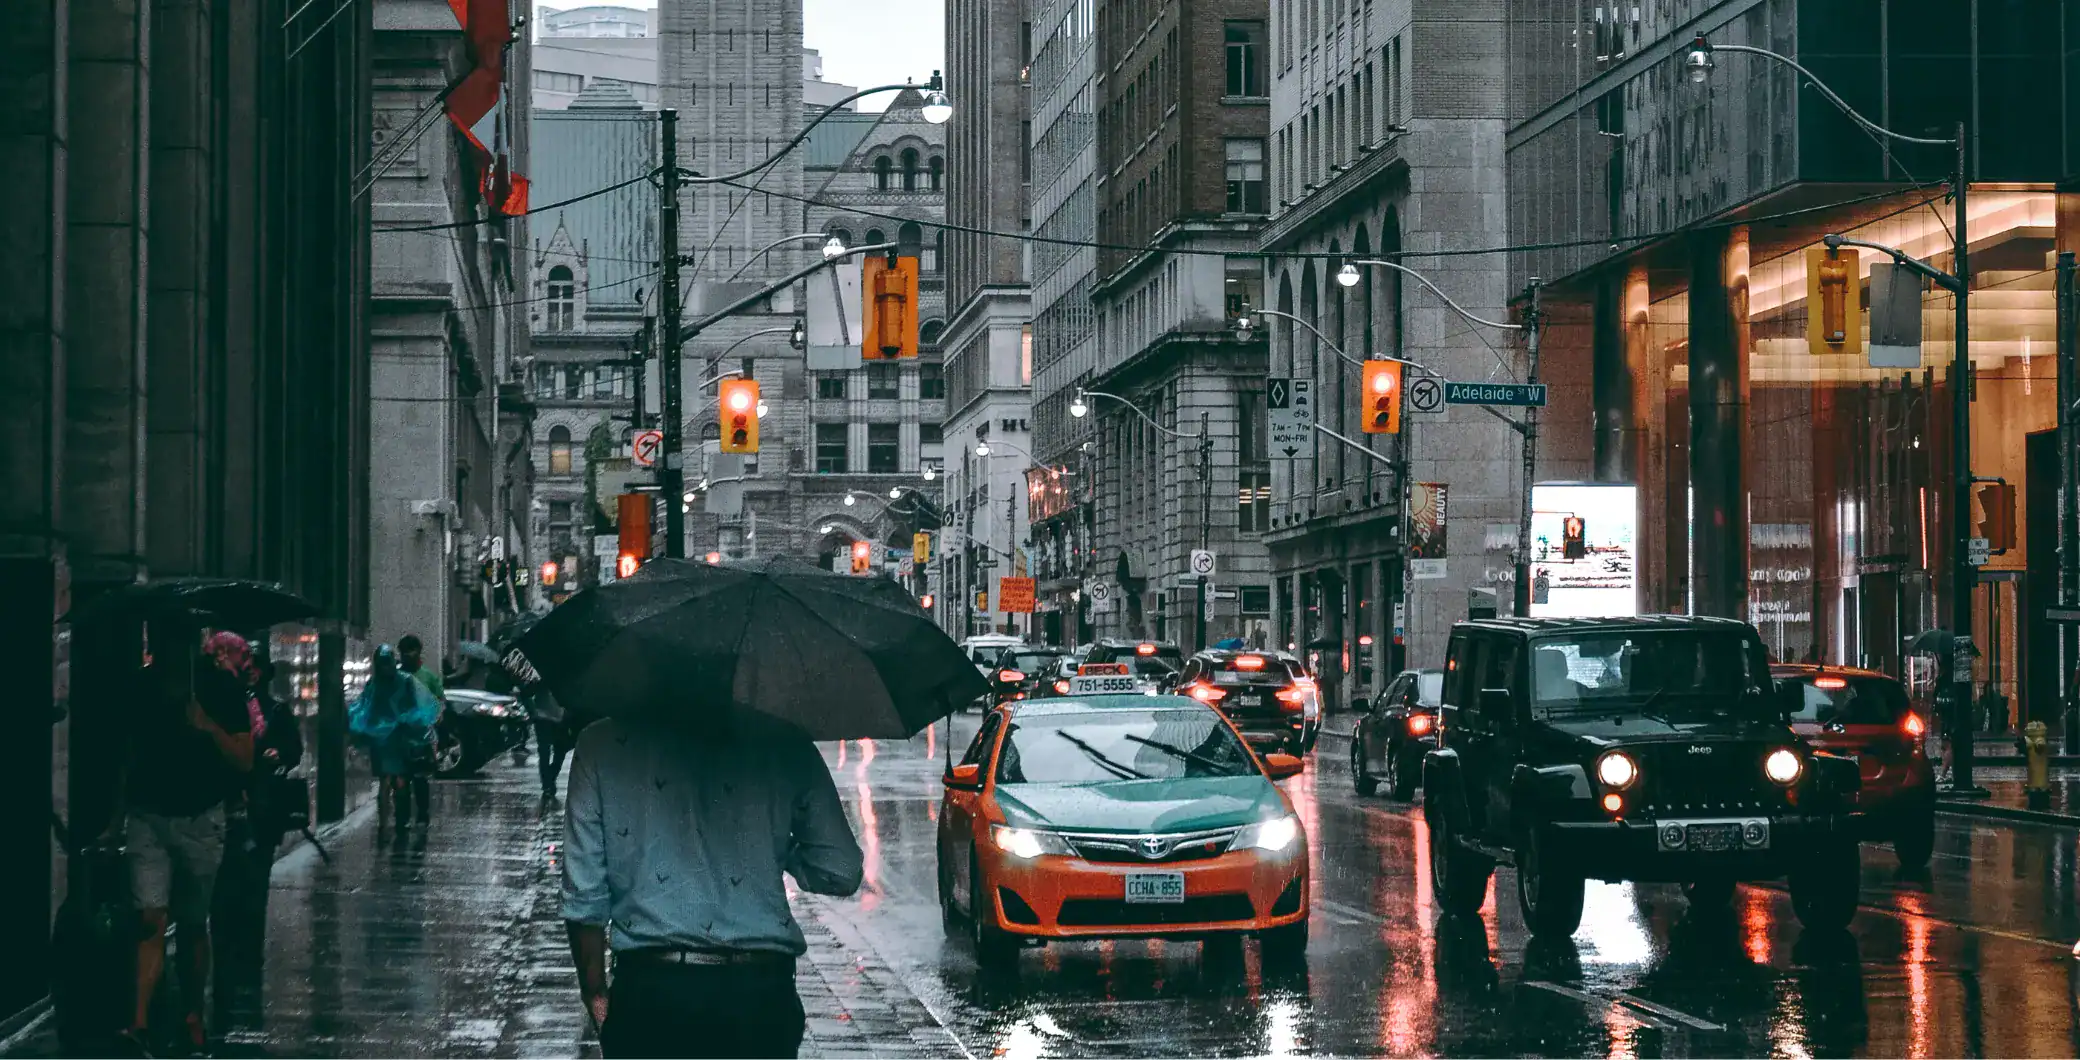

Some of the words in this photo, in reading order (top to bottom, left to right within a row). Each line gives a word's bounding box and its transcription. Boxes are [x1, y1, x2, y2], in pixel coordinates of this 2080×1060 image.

[1451, 385, 1514, 400] Adelaide
[1528, 387, 1540, 401] W
[1272, 422, 1285, 432] 7AM
[1273, 434, 1308, 442] MON-FRI
[1436, 487, 1446, 526] BEAUTY
[1086, 666, 1120, 676] BECK
[1078, 679, 1133, 691] 751-5555
[1688, 745, 1712, 754] Jeep
[1129, 881, 1155, 895] CCHA
[1161, 881, 1181, 895] 855
